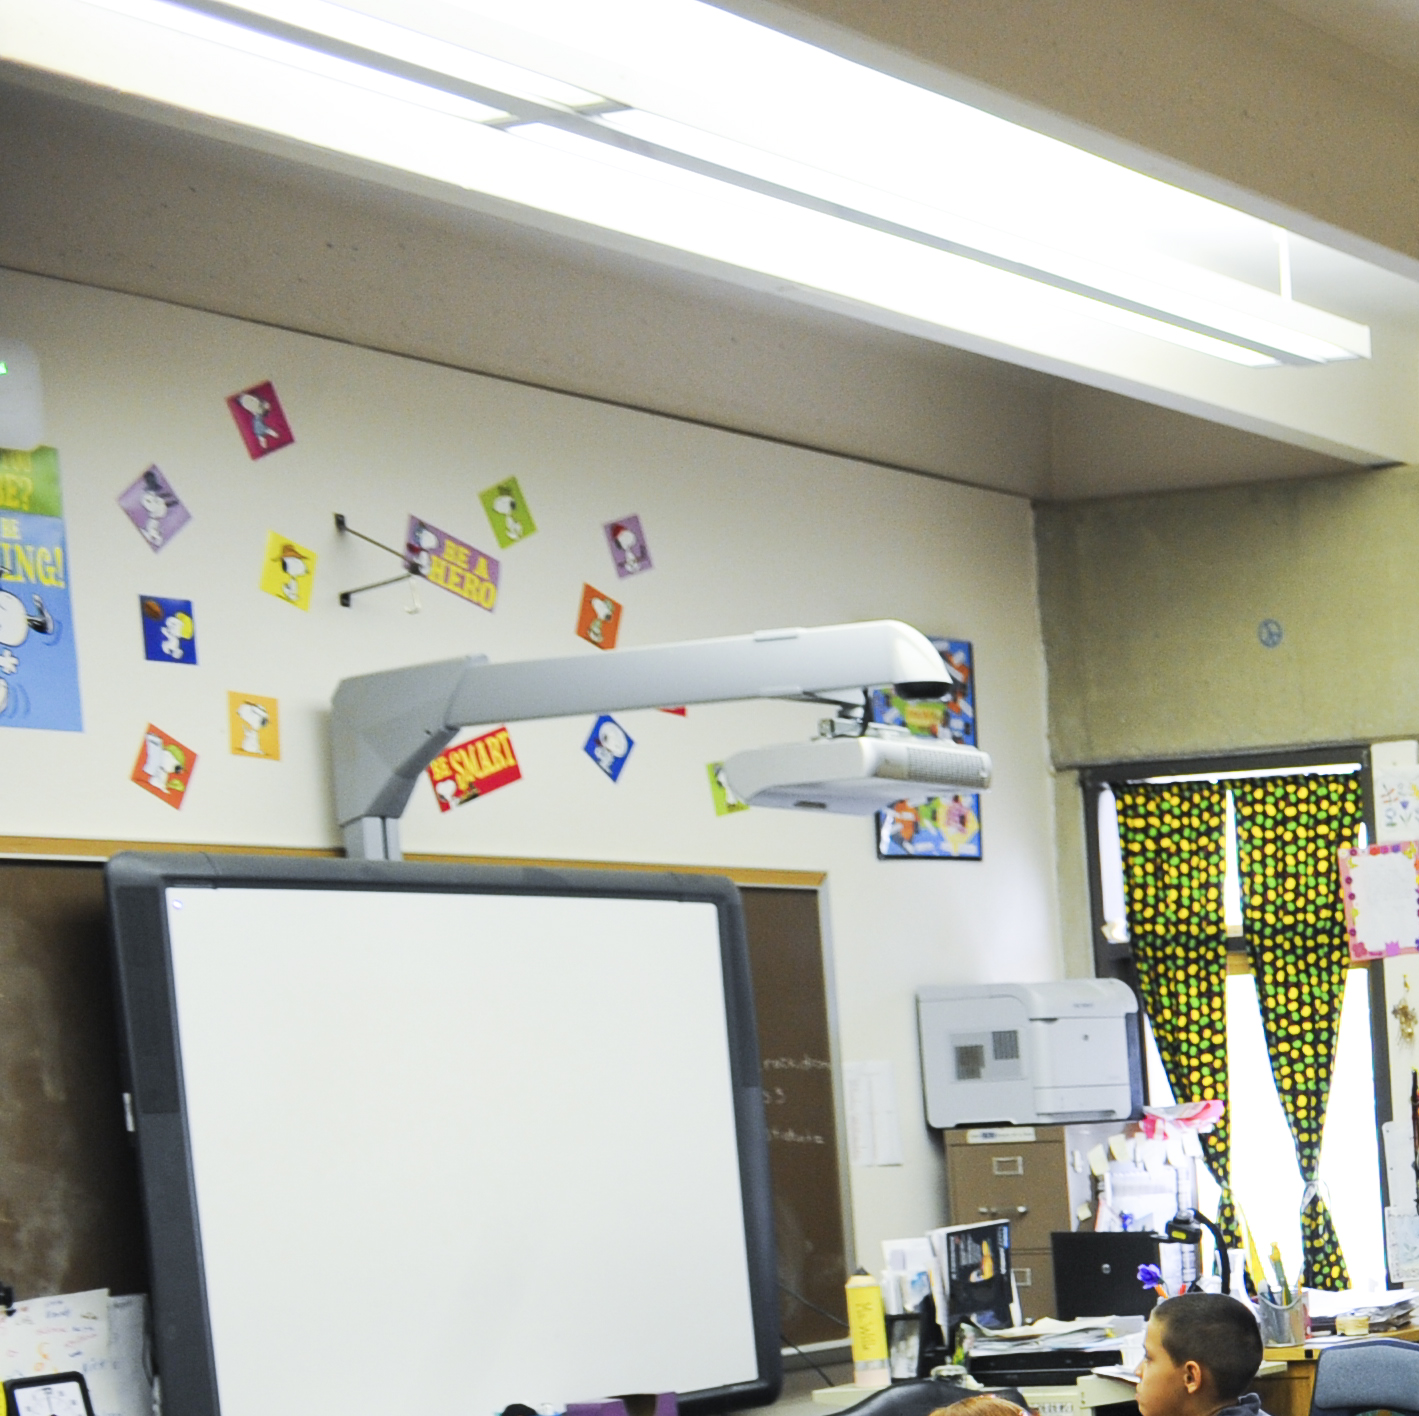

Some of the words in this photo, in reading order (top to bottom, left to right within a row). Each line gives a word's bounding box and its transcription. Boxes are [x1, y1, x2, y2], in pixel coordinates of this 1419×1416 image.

[0, 545, 65, 588] ING!
[428, 555, 497, 610] HERO
[444, 539, 470, 568] BE
[474, 556, 489, 579] A
[430, 755, 452, 782] BE
[451, 731, 516, 791] SMART
